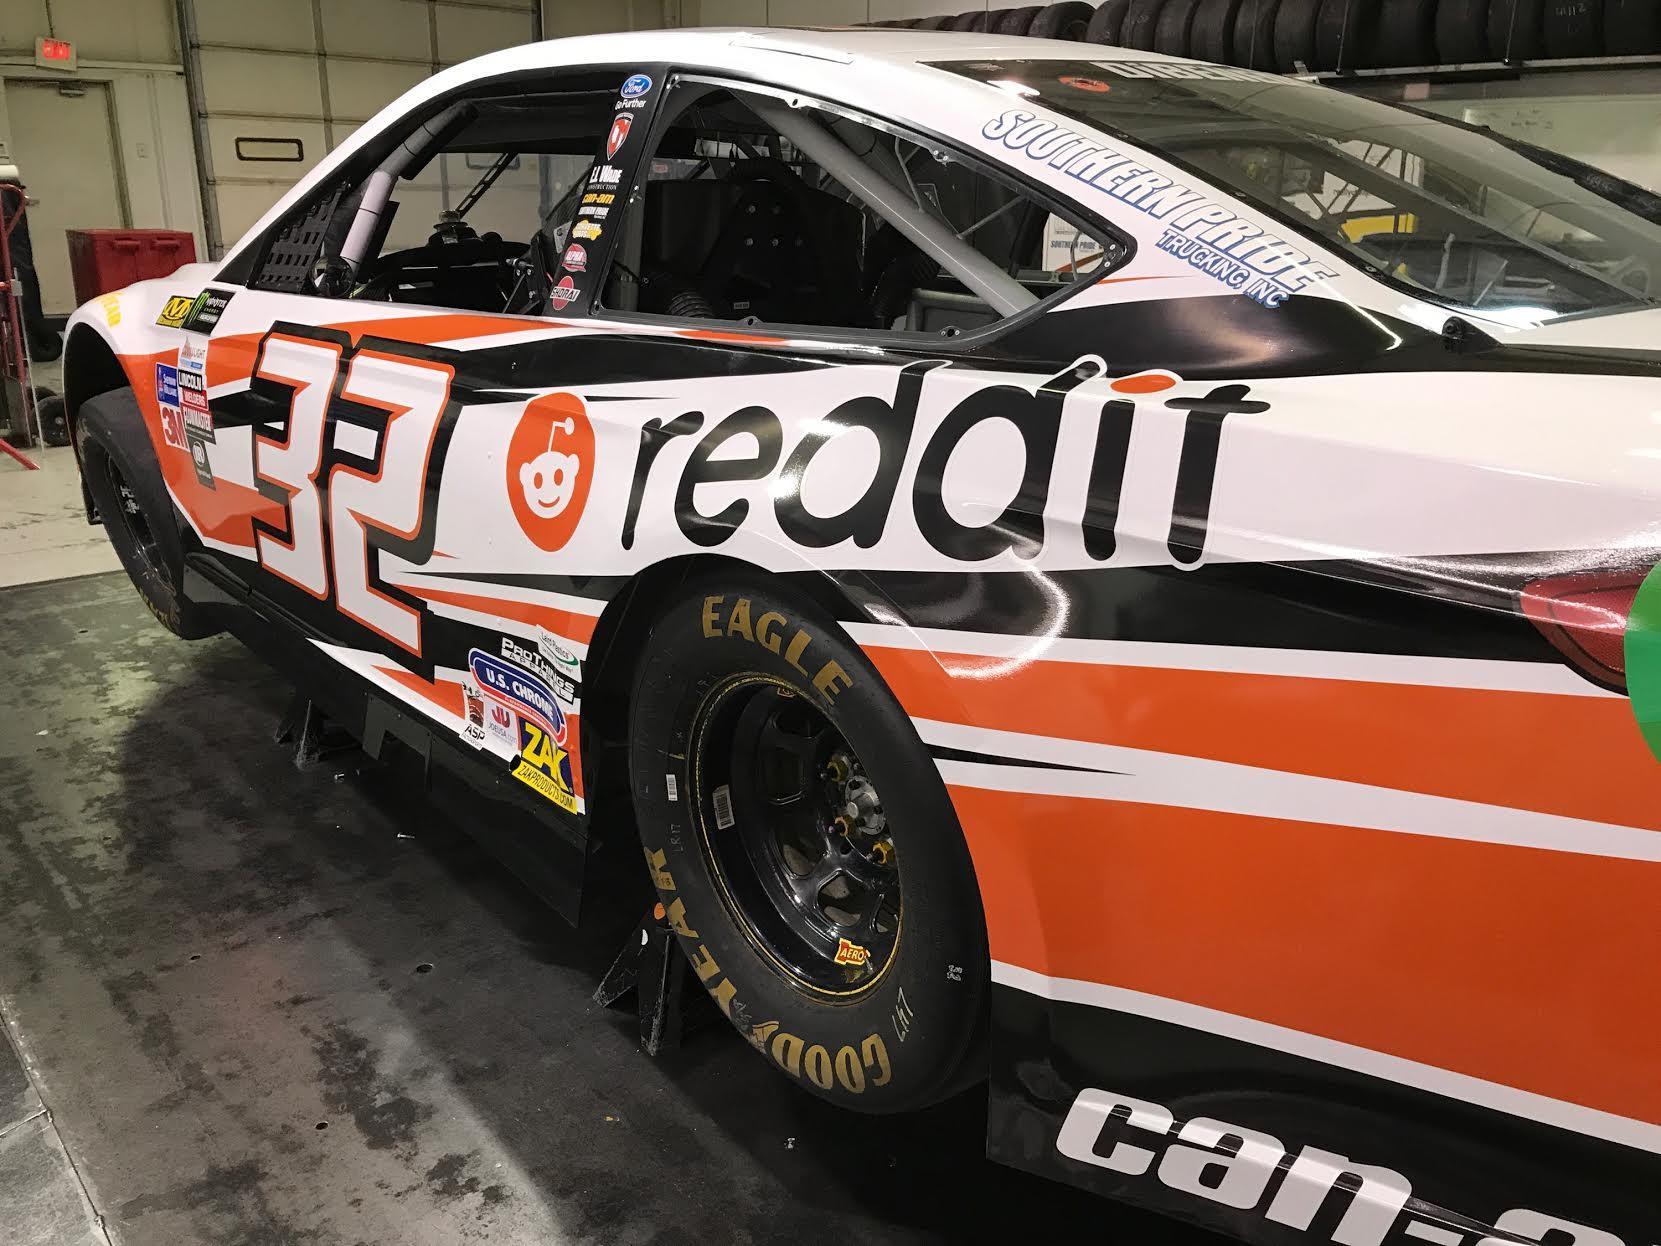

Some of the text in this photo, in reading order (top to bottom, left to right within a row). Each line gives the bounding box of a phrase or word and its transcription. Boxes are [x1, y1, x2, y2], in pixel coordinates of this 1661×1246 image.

[622, 99, 647, 109] Further
[624, 79, 646, 94] Ford
[982, 109, 1341, 293] SOUTHERN PRIDE
[1243, 277, 1290, 308] INC
[179, 371, 202, 391] LINCOLN
[162, 406, 188, 450] 3M
[620, 360, 1272, 565] reddit
[253, 328, 456, 660] 32
[702, 595, 854, 706] EAGLE
[485, 667, 510, 691] U.S.
[512, 681, 554, 722] CHROME
[464, 724, 486, 740] ASP
[521, 722, 570, 793] ZAK
[840, 947, 865, 961] AERO
[1056, 1087, 1661, 1246] can-
